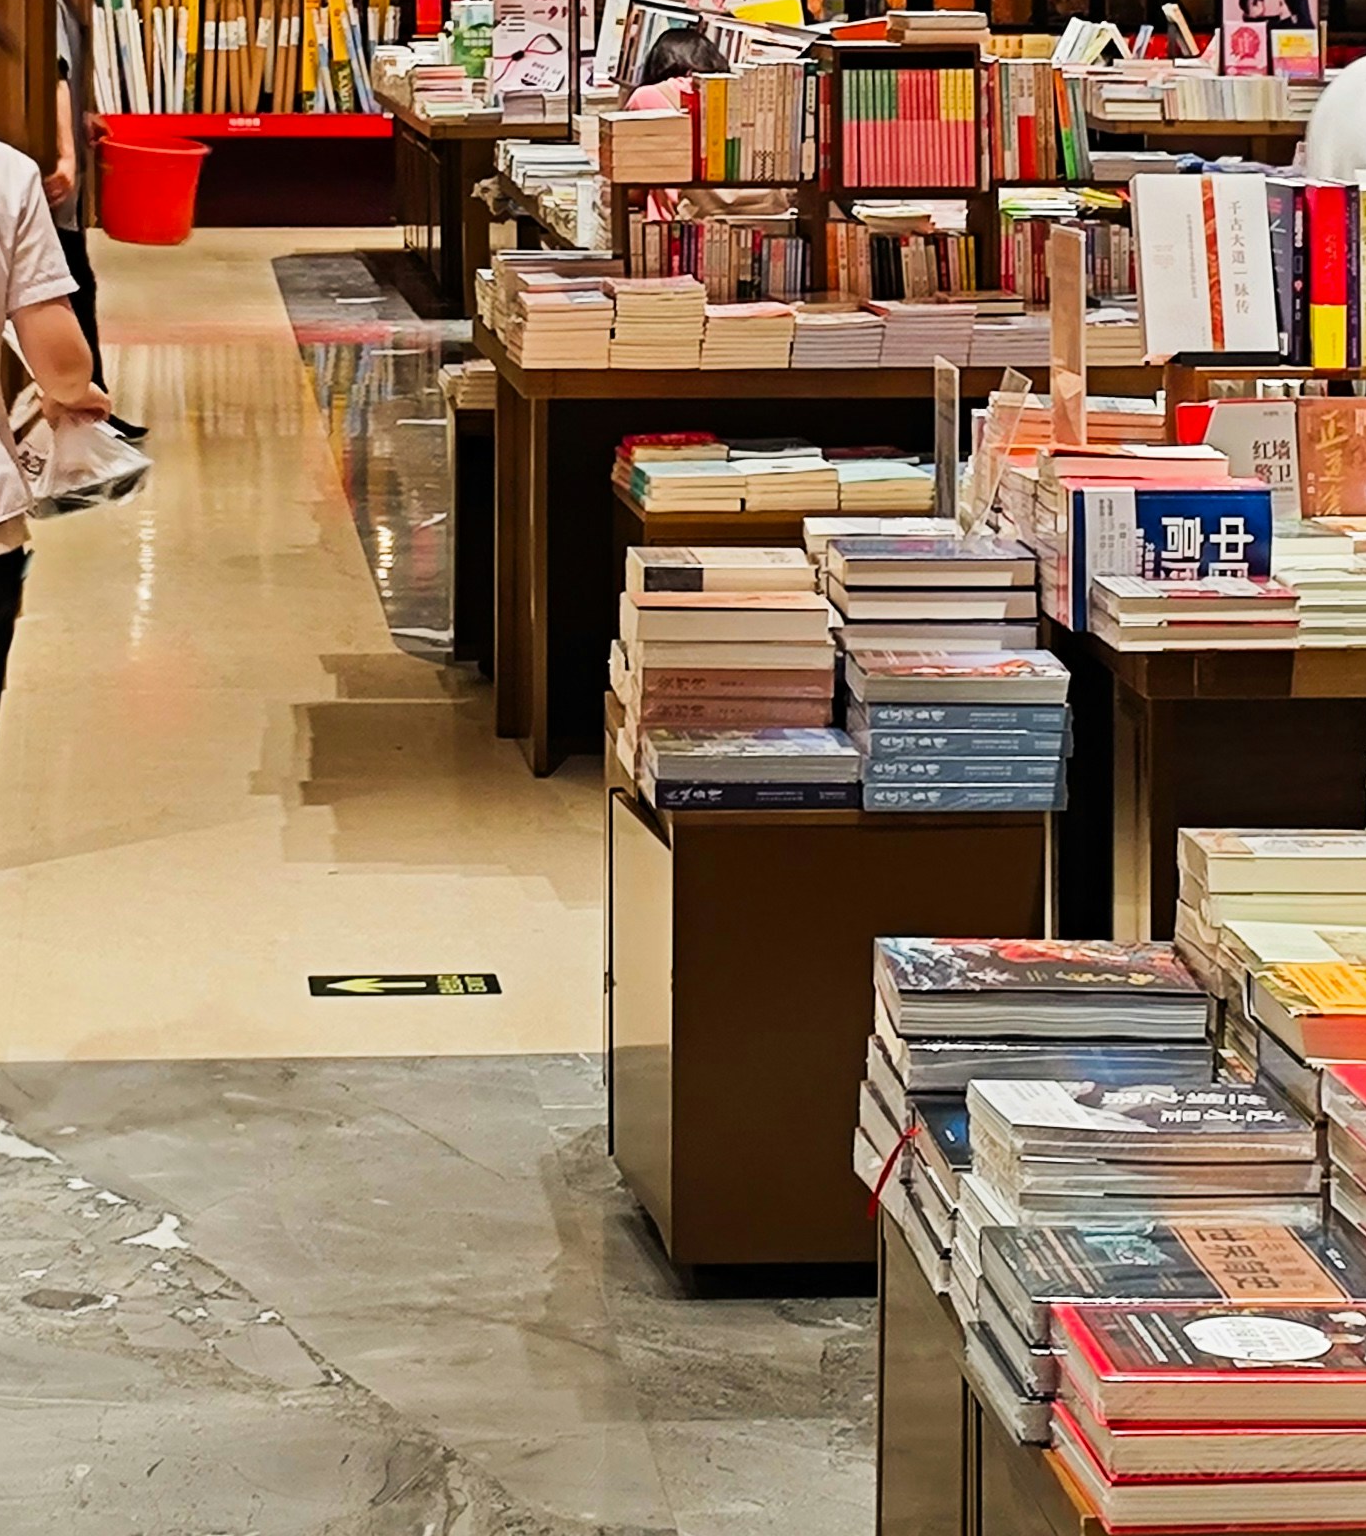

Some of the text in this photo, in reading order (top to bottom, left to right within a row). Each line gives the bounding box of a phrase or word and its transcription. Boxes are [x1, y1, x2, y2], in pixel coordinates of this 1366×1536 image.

[1228, 199, 1250, 315] 千古大道一脉传
[1251, 440, 1291, 461] 红墙
